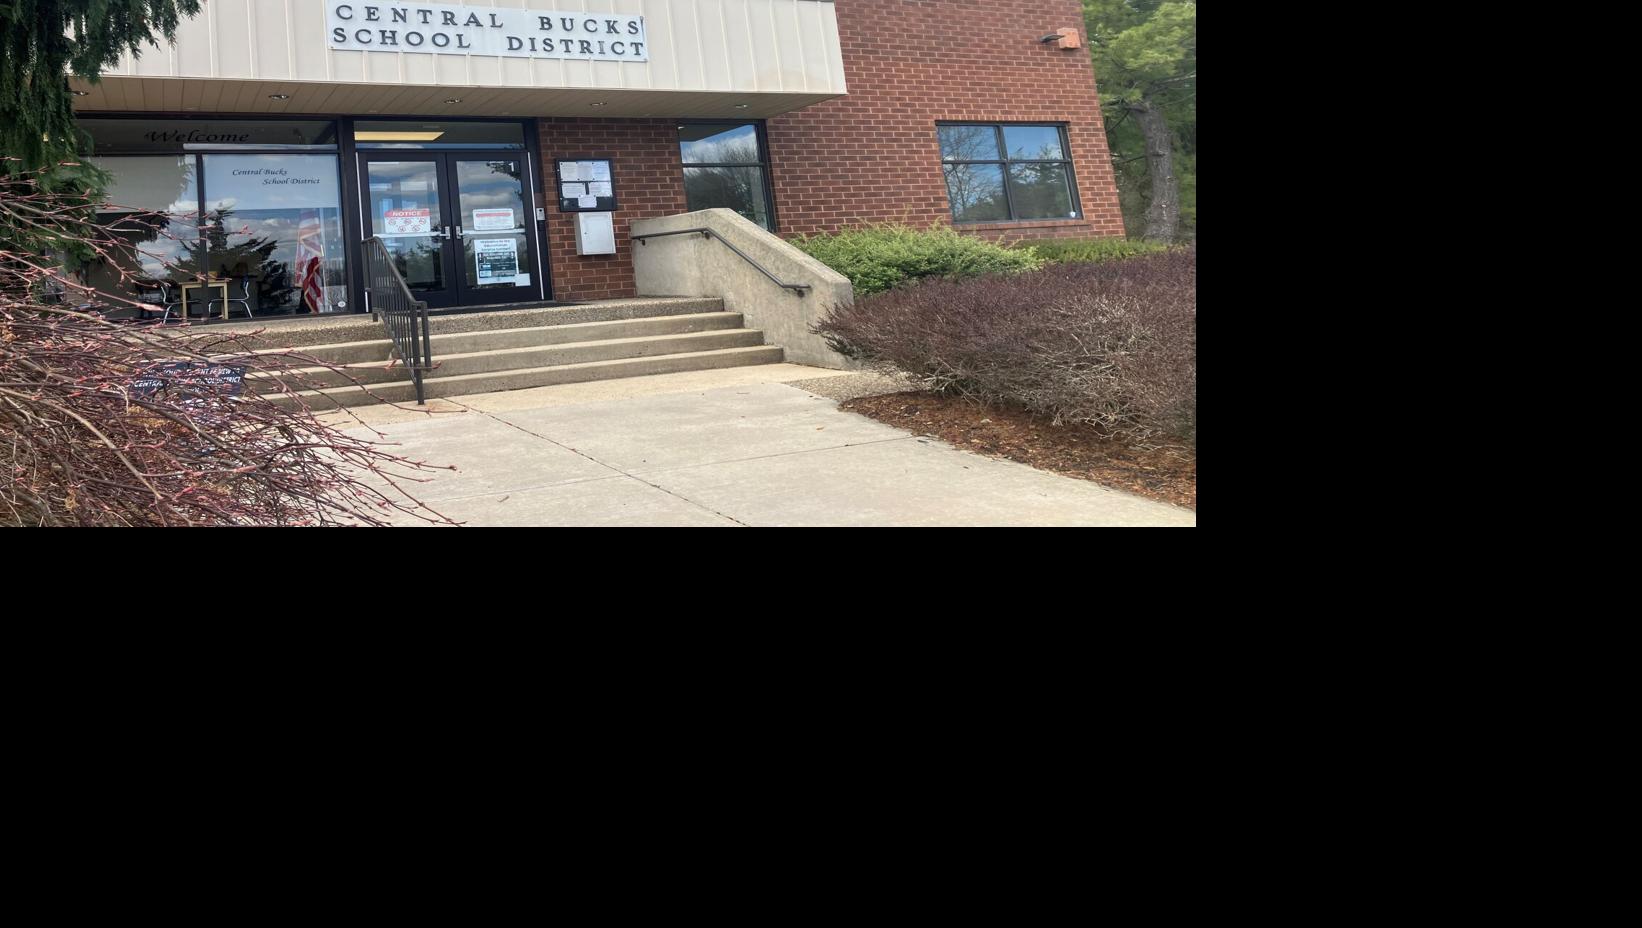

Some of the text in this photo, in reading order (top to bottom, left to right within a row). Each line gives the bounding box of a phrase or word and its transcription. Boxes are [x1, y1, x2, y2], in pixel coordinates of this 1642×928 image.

[335, 4, 640, 35] CENTRAL BUCKS
[333, 27, 645, 56] SCHOOL DISTRICT
[144, 129, 249, 142] Welcome
[232, 168, 288, 176] Central Bucks
[262, 177, 321, 185] School District
